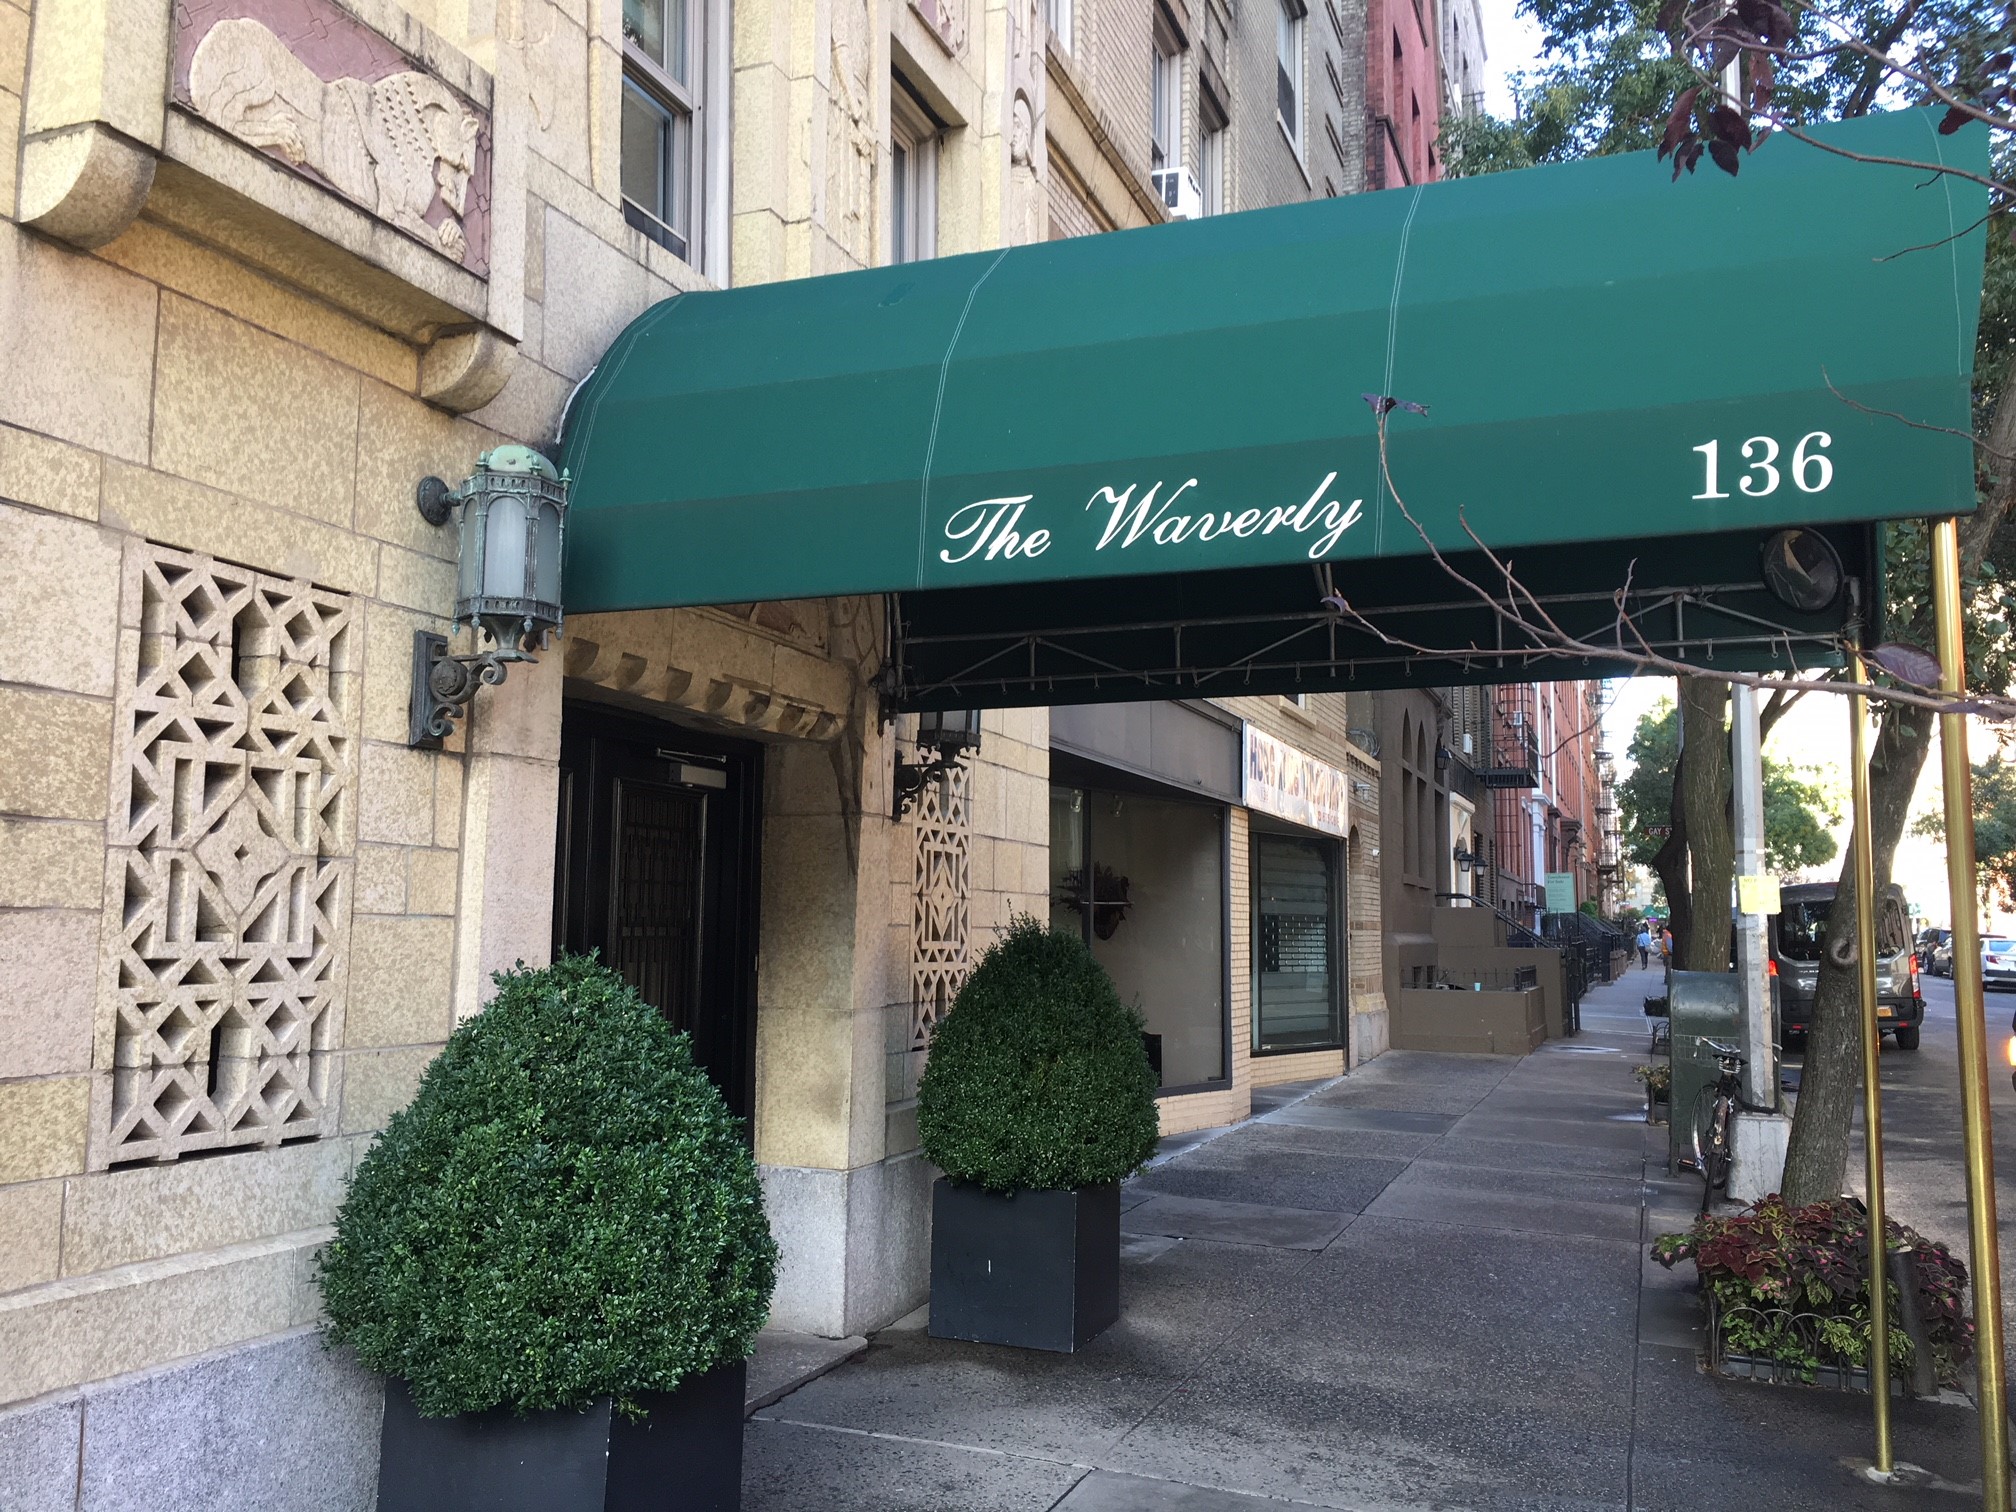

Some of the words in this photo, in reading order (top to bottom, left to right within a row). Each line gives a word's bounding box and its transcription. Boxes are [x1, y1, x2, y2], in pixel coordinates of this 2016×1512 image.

[1692, 431, 1833, 499] 136
[940, 494, 1051, 563] The
[1085, 471, 1363, 559] Waverly
[1648, 827, 1662, 836] GAY
